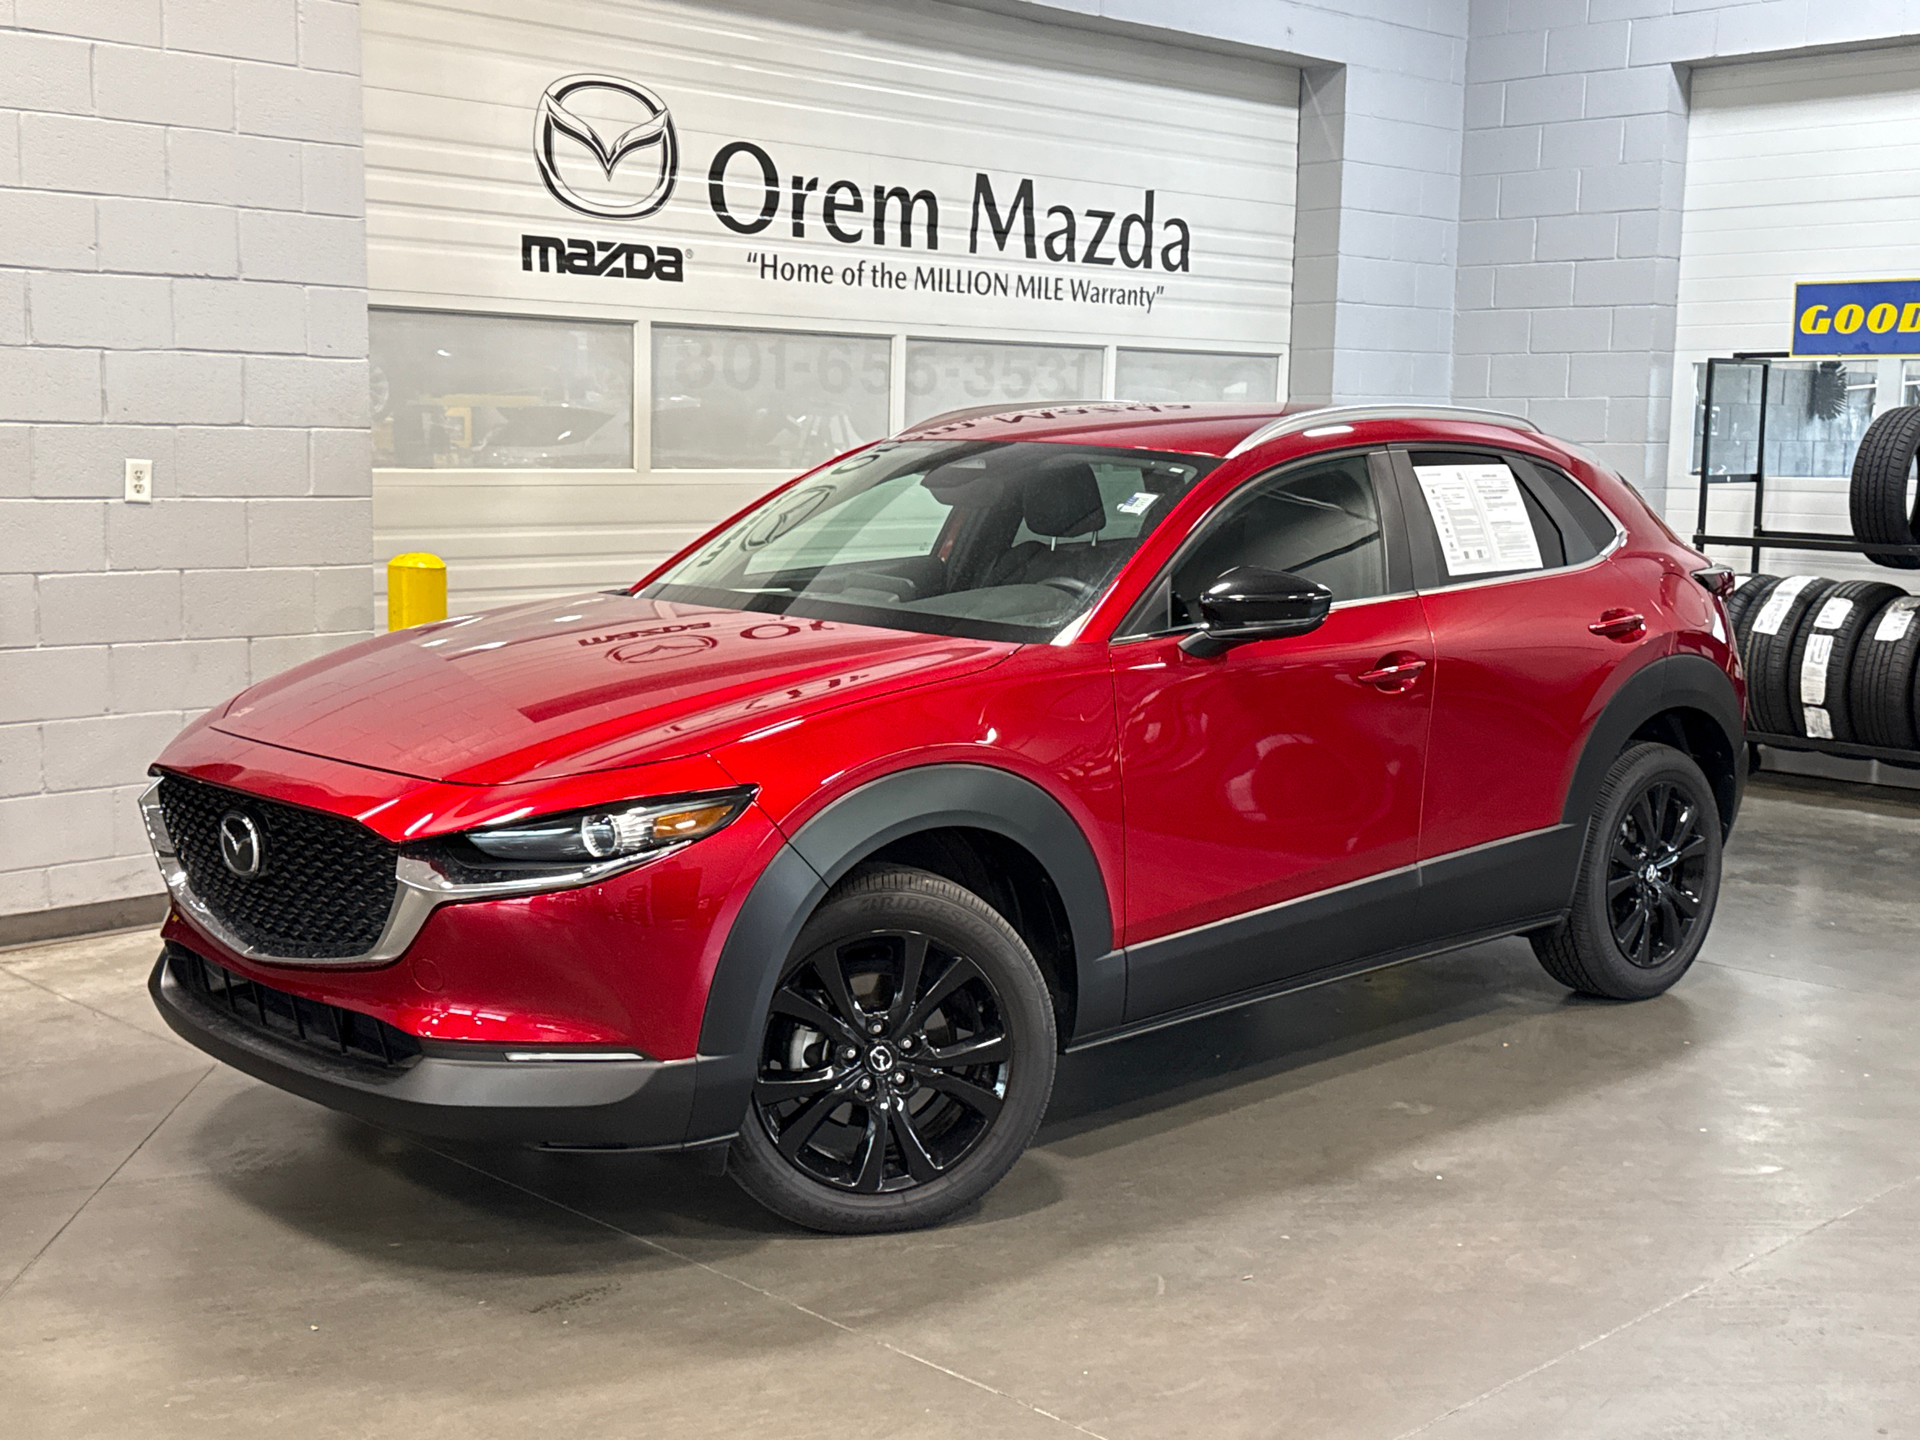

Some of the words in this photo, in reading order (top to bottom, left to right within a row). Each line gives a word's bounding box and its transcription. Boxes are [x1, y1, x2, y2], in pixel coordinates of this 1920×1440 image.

[708, 141, 939, 250] Orem
[969, 172, 1190, 272] Mazda
[842, 260, 866, 287] of
[871, 262, 907, 290] the
[914, 266, 1009, 297] MILLION
[1015, 274, 1064, 301] MILE
[1800, 303, 1920, 334] GOOD
